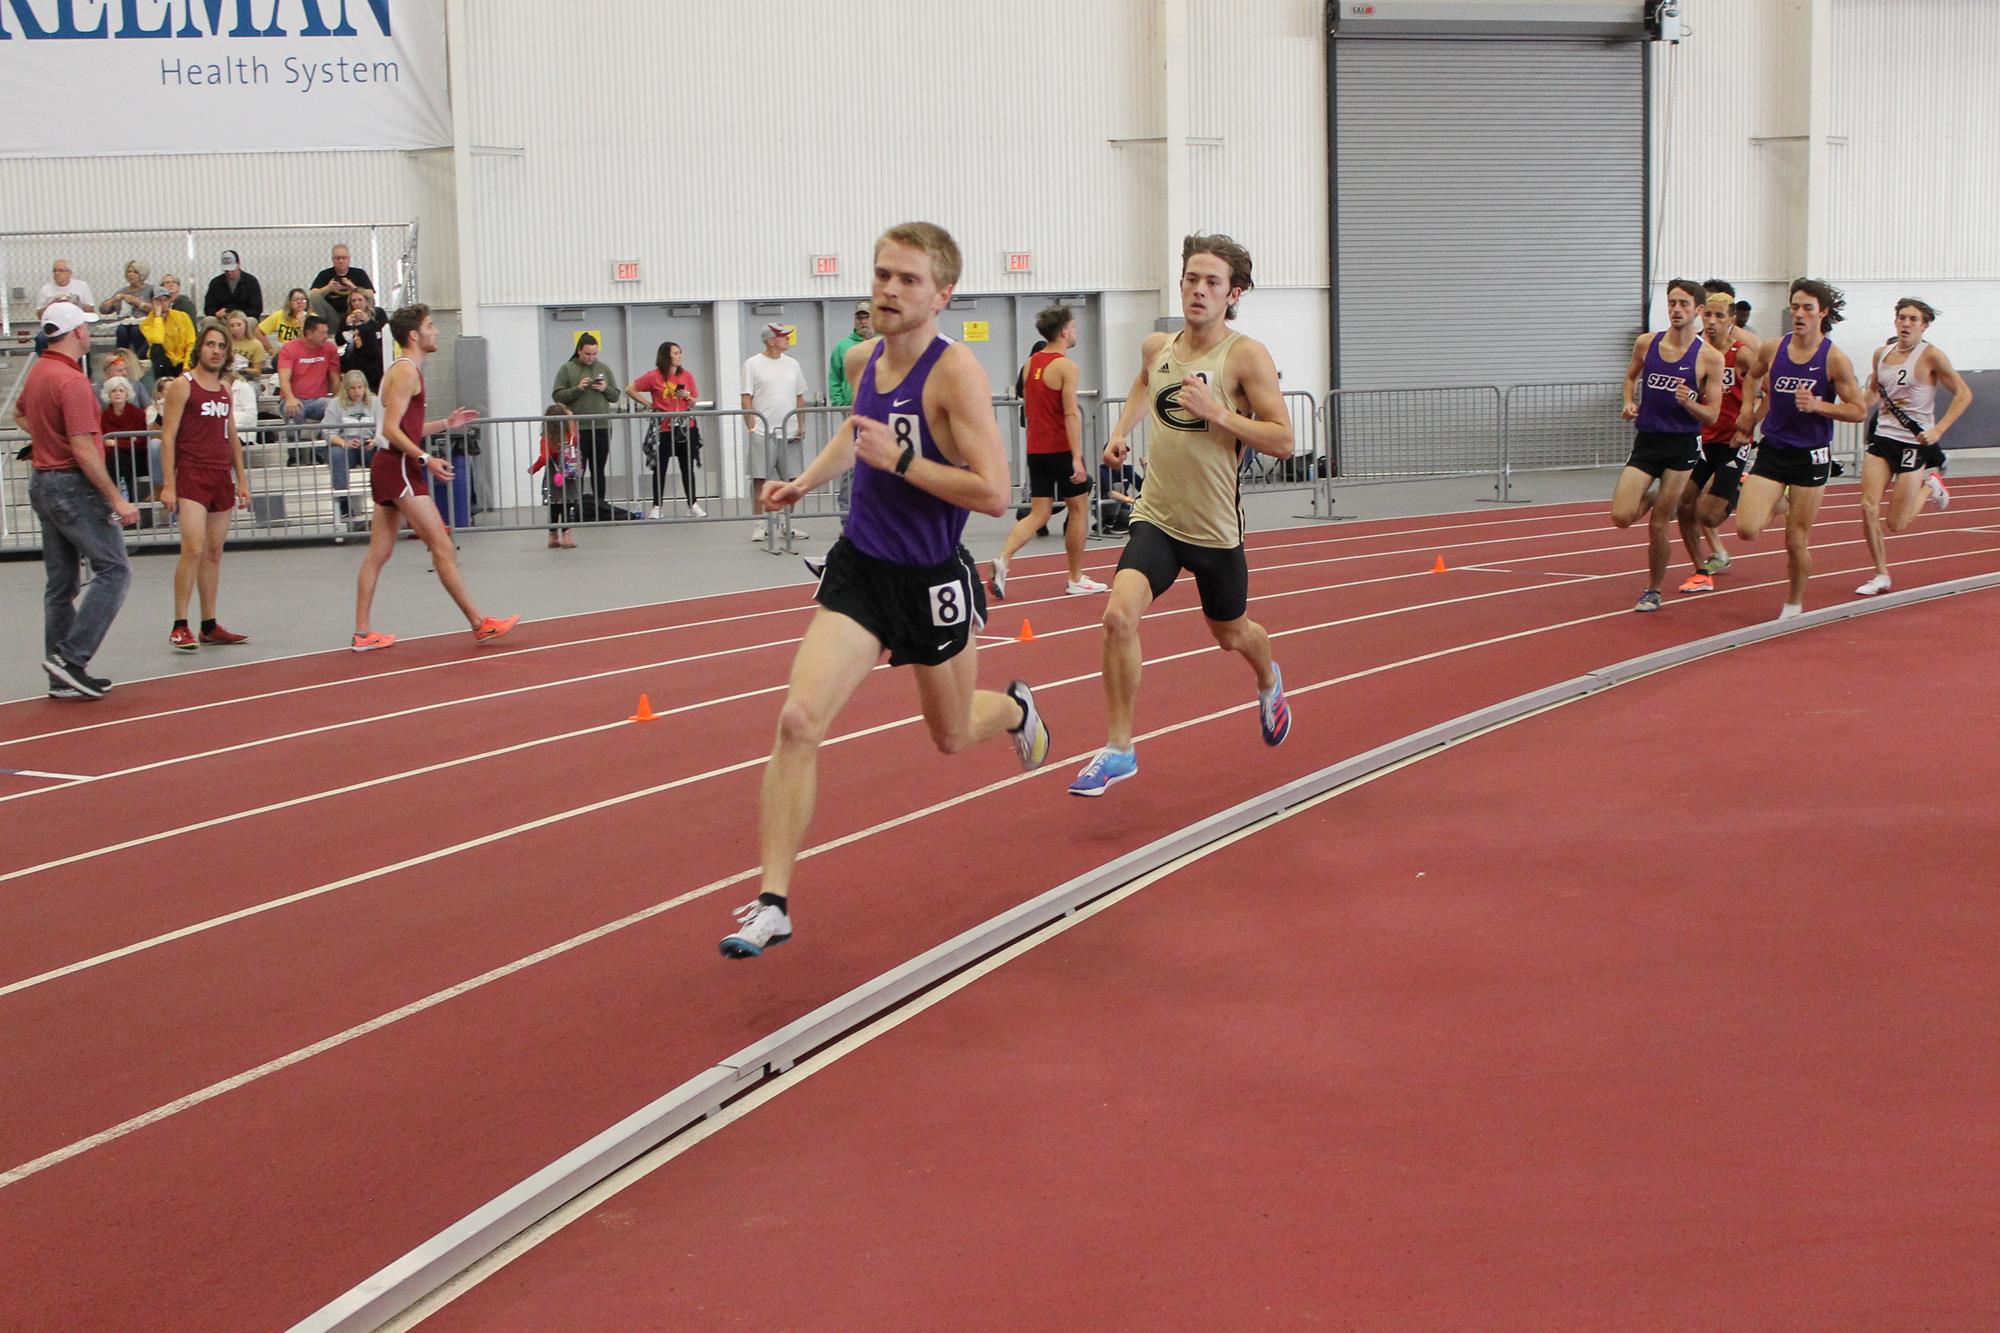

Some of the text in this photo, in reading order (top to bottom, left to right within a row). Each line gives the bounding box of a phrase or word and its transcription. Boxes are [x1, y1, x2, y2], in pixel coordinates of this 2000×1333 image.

[161, 55, 399, 93] Health System
[618, 263, 638, 279] EXIT
[817, 257, 836, 272] EXIT
[1647, 373, 1686, 392] SBU
[1722, 368, 1733, 385] 3
[1897, 369, 1907, 386] 2
[200, 400, 229, 418] SNU
[894, 416, 914, 453] 8
[1903, 449, 1914, 466] 2
[937, 586, 959, 624] 8
